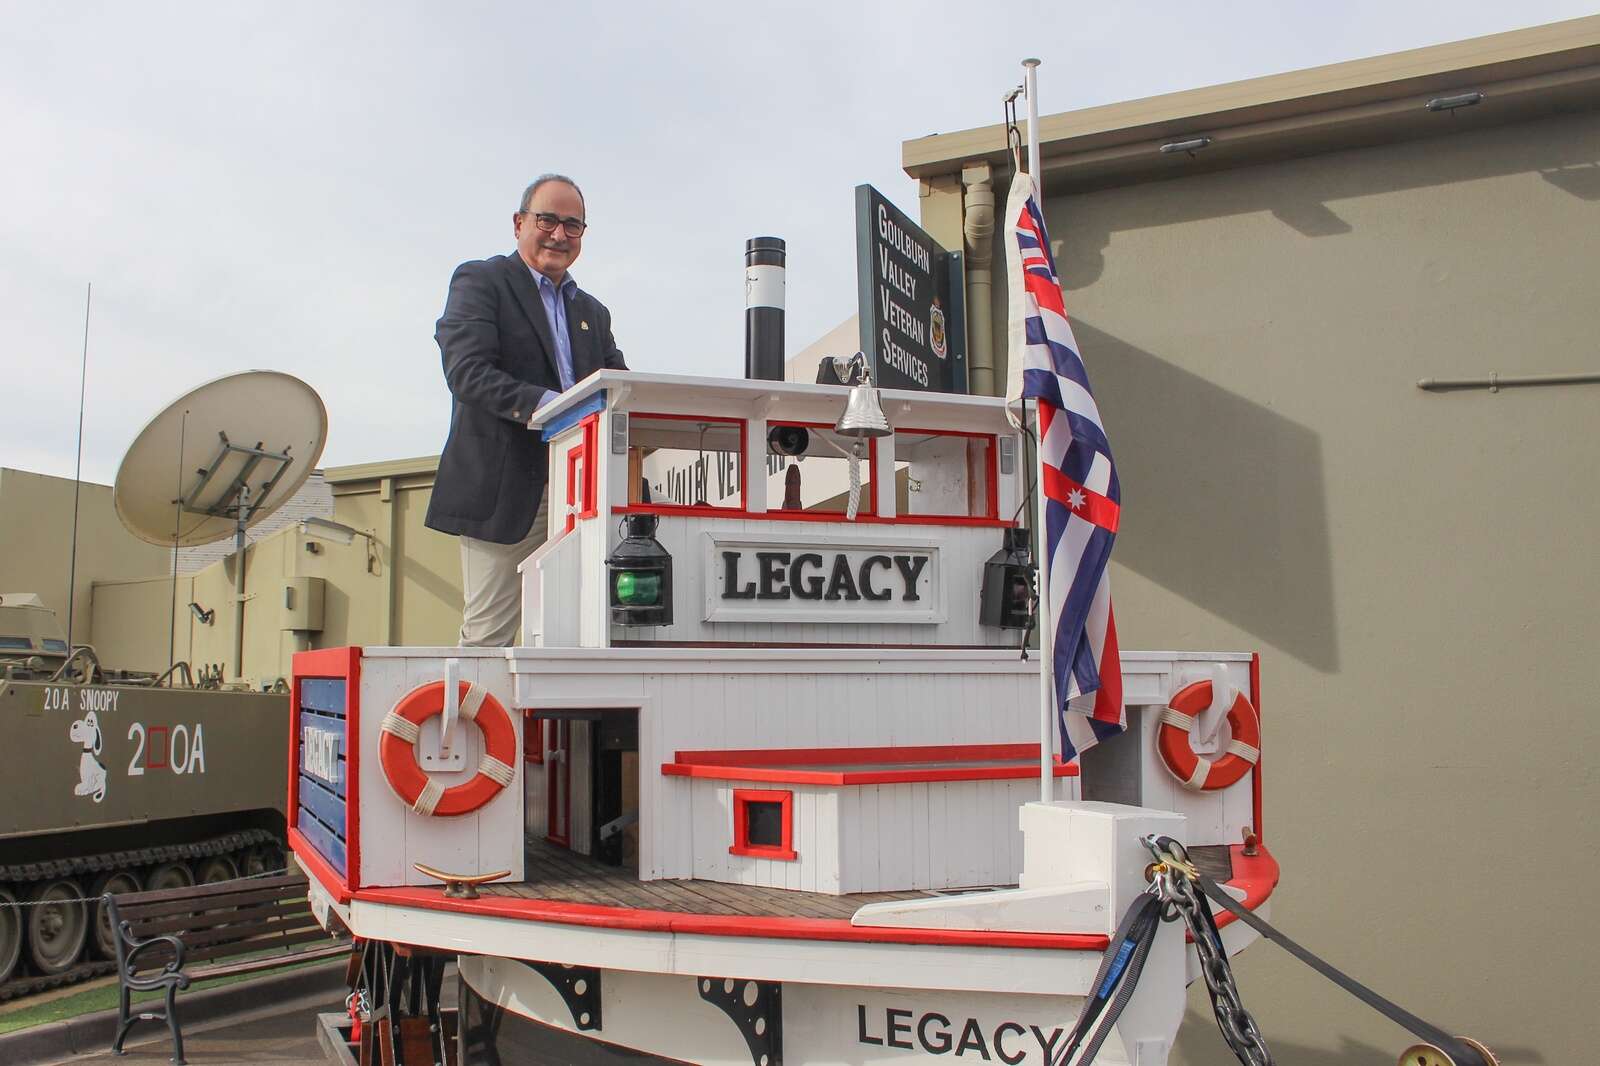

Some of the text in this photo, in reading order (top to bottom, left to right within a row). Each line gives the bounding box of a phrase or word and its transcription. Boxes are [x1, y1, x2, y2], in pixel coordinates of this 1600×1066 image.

[878, 203, 930, 275] GOULBURN
[879, 242, 916, 301] VALLEY
[880, 284, 925, 347] VETERAN
[882, 327, 929, 388] SERVICES
[721, 551, 928, 601] LEGACY
[80, 688, 120, 712] SNOOPY
[857, 1004, 1064, 1066] LEGACY
